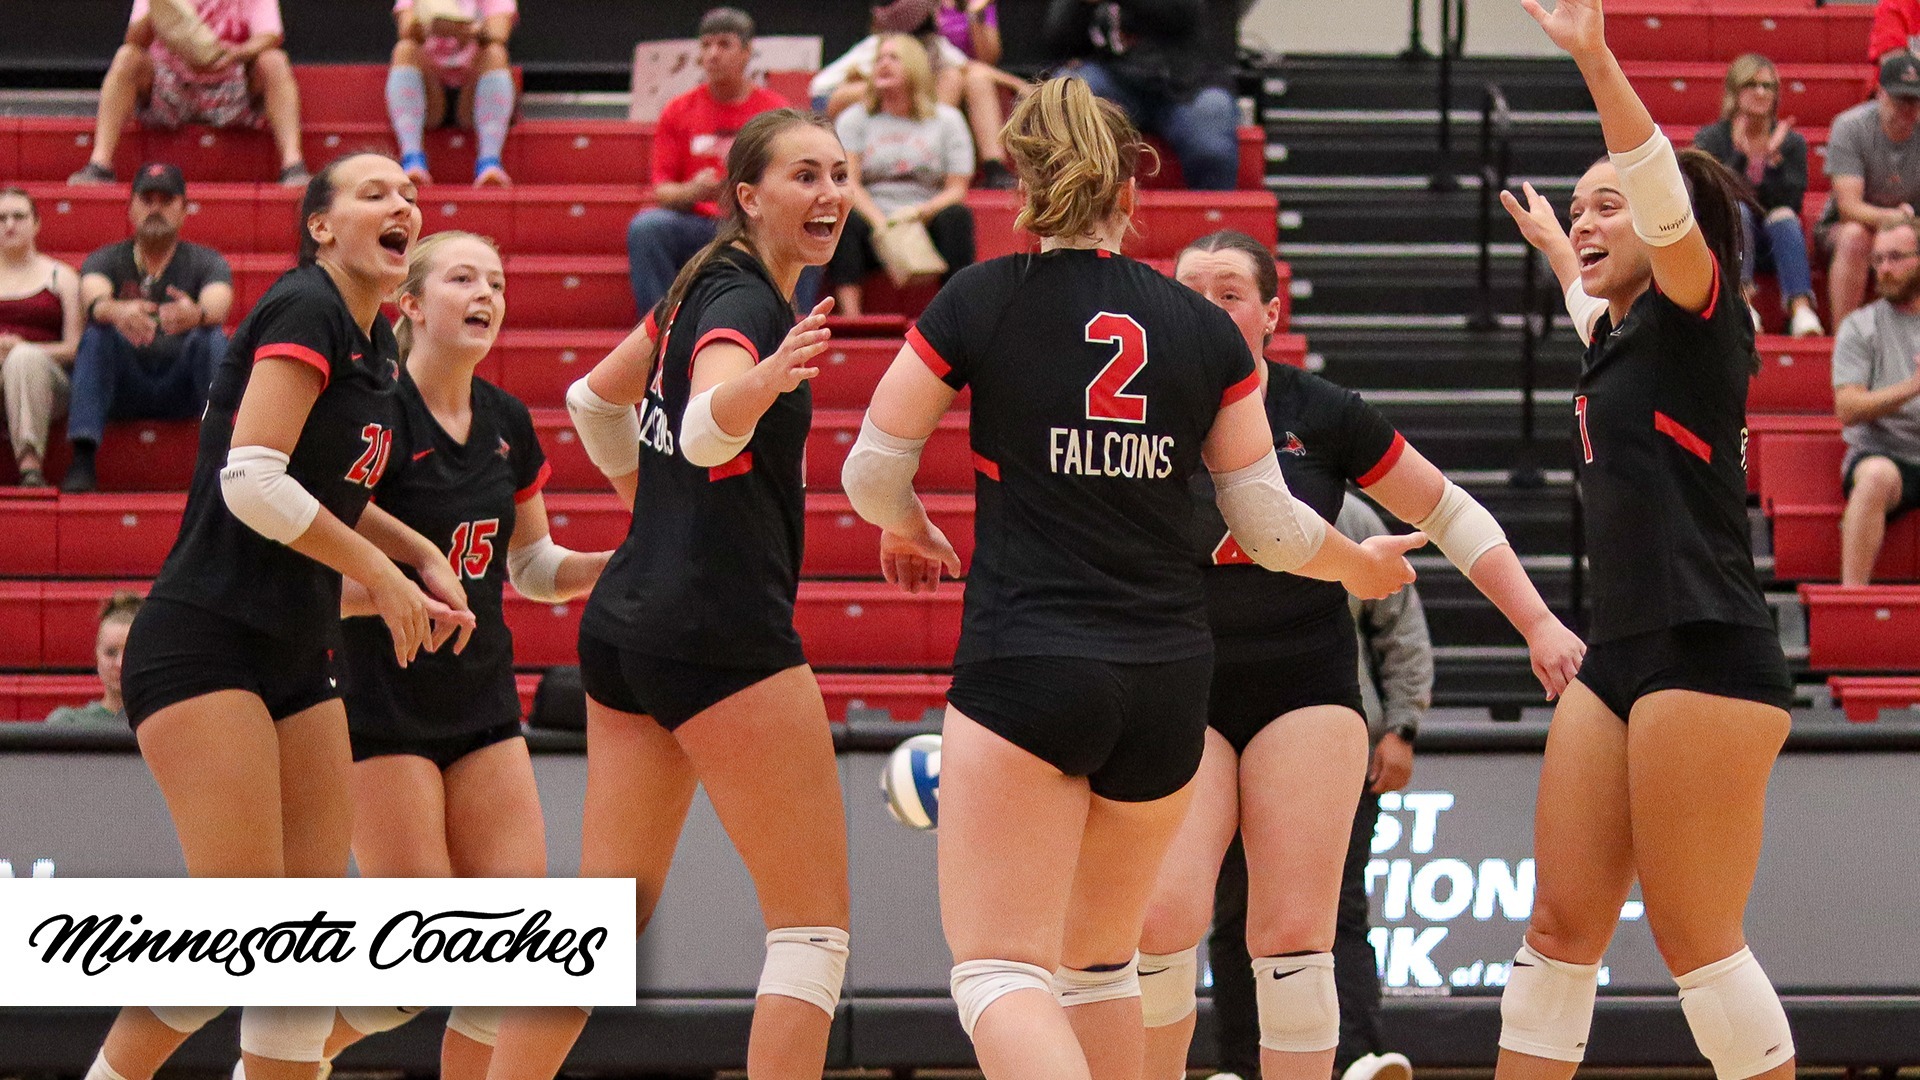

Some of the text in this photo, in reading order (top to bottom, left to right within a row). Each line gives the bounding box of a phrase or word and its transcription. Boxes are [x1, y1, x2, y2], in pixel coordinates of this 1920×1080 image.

[1085, 311, 1149, 424] 2
[344, 422, 393, 489] 20
[1050, 427, 1174, 479] FALCONS
[448, 518, 499, 580] 15
